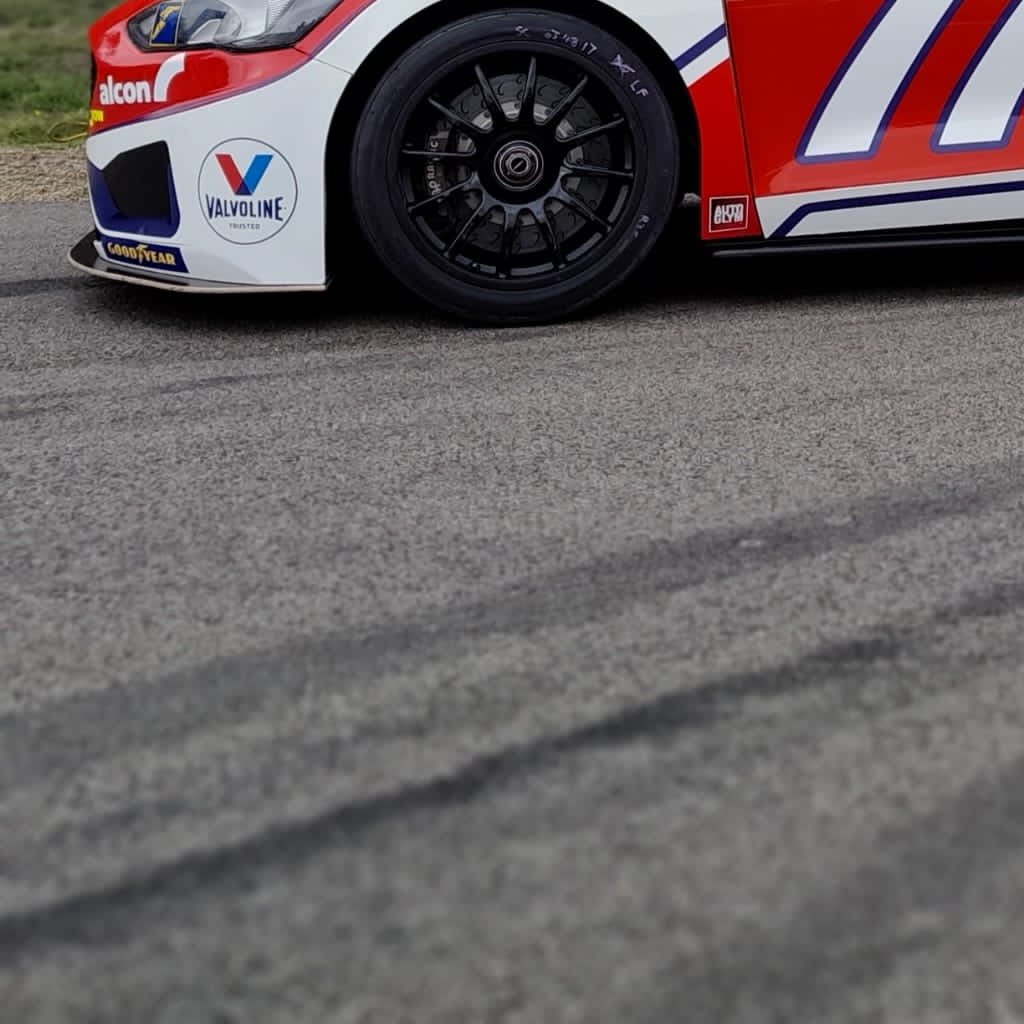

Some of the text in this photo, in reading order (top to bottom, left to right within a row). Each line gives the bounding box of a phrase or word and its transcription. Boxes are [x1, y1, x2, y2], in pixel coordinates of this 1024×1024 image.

[99, 74, 151, 105] alcon
[205, 193, 285, 222] VALVOLINE
[107, 241, 177, 266] GOODYEAR
